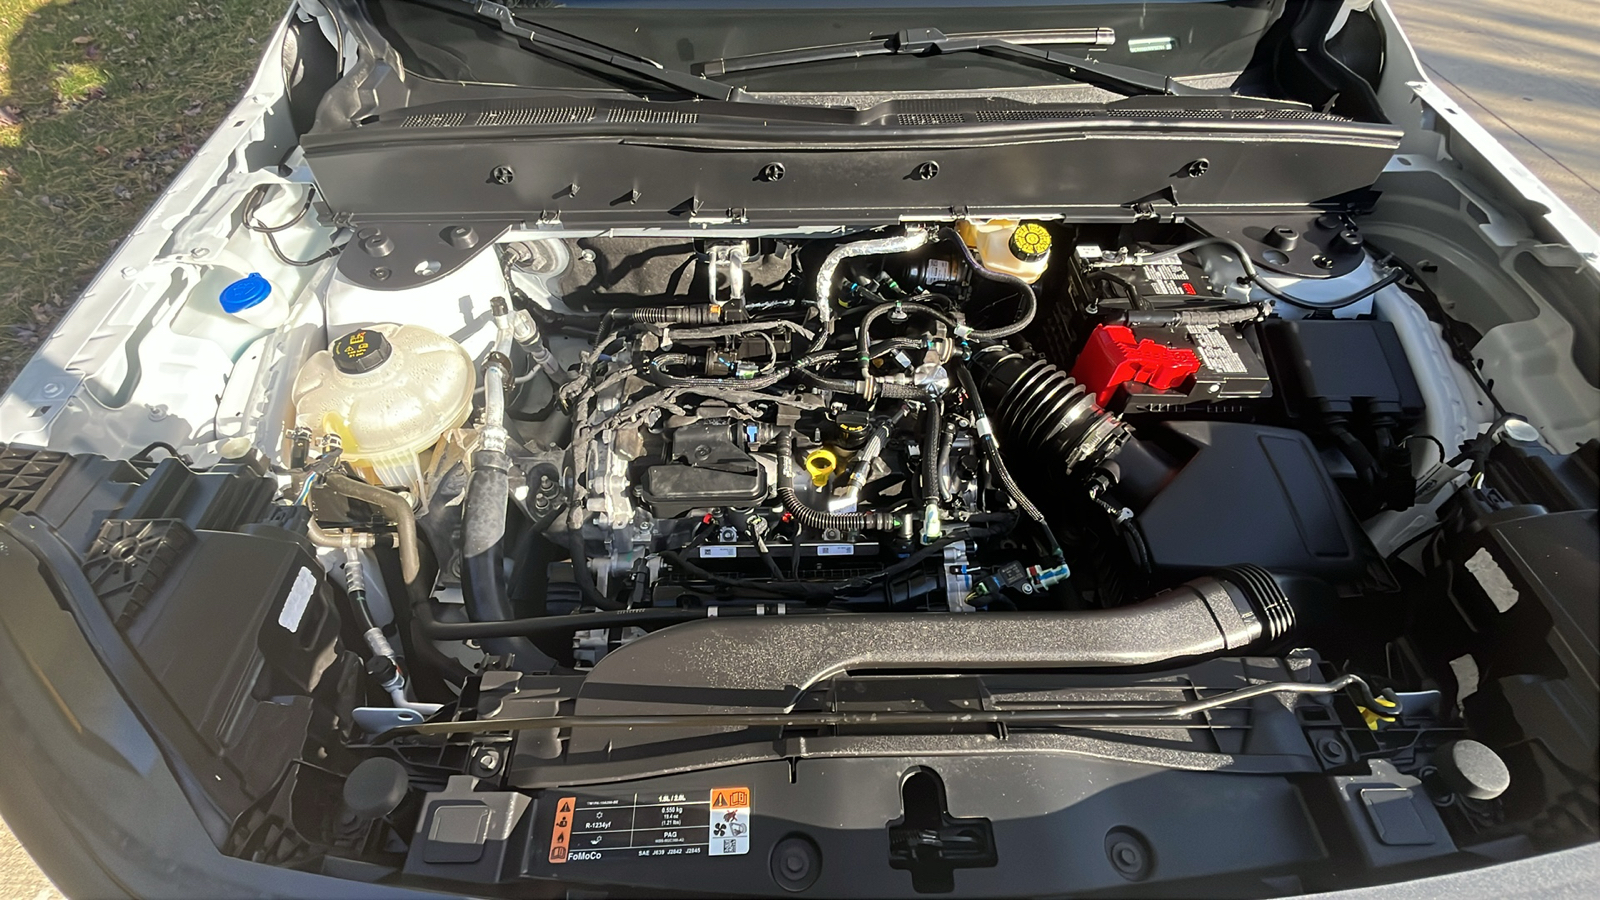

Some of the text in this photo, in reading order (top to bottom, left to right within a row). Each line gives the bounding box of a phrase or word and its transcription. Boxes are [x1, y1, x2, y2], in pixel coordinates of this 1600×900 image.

[676, 806, 683, 814] kg
[585, 821, 612, 829] R-1234yf
[567, 851, 602, 861] FoMoCo
